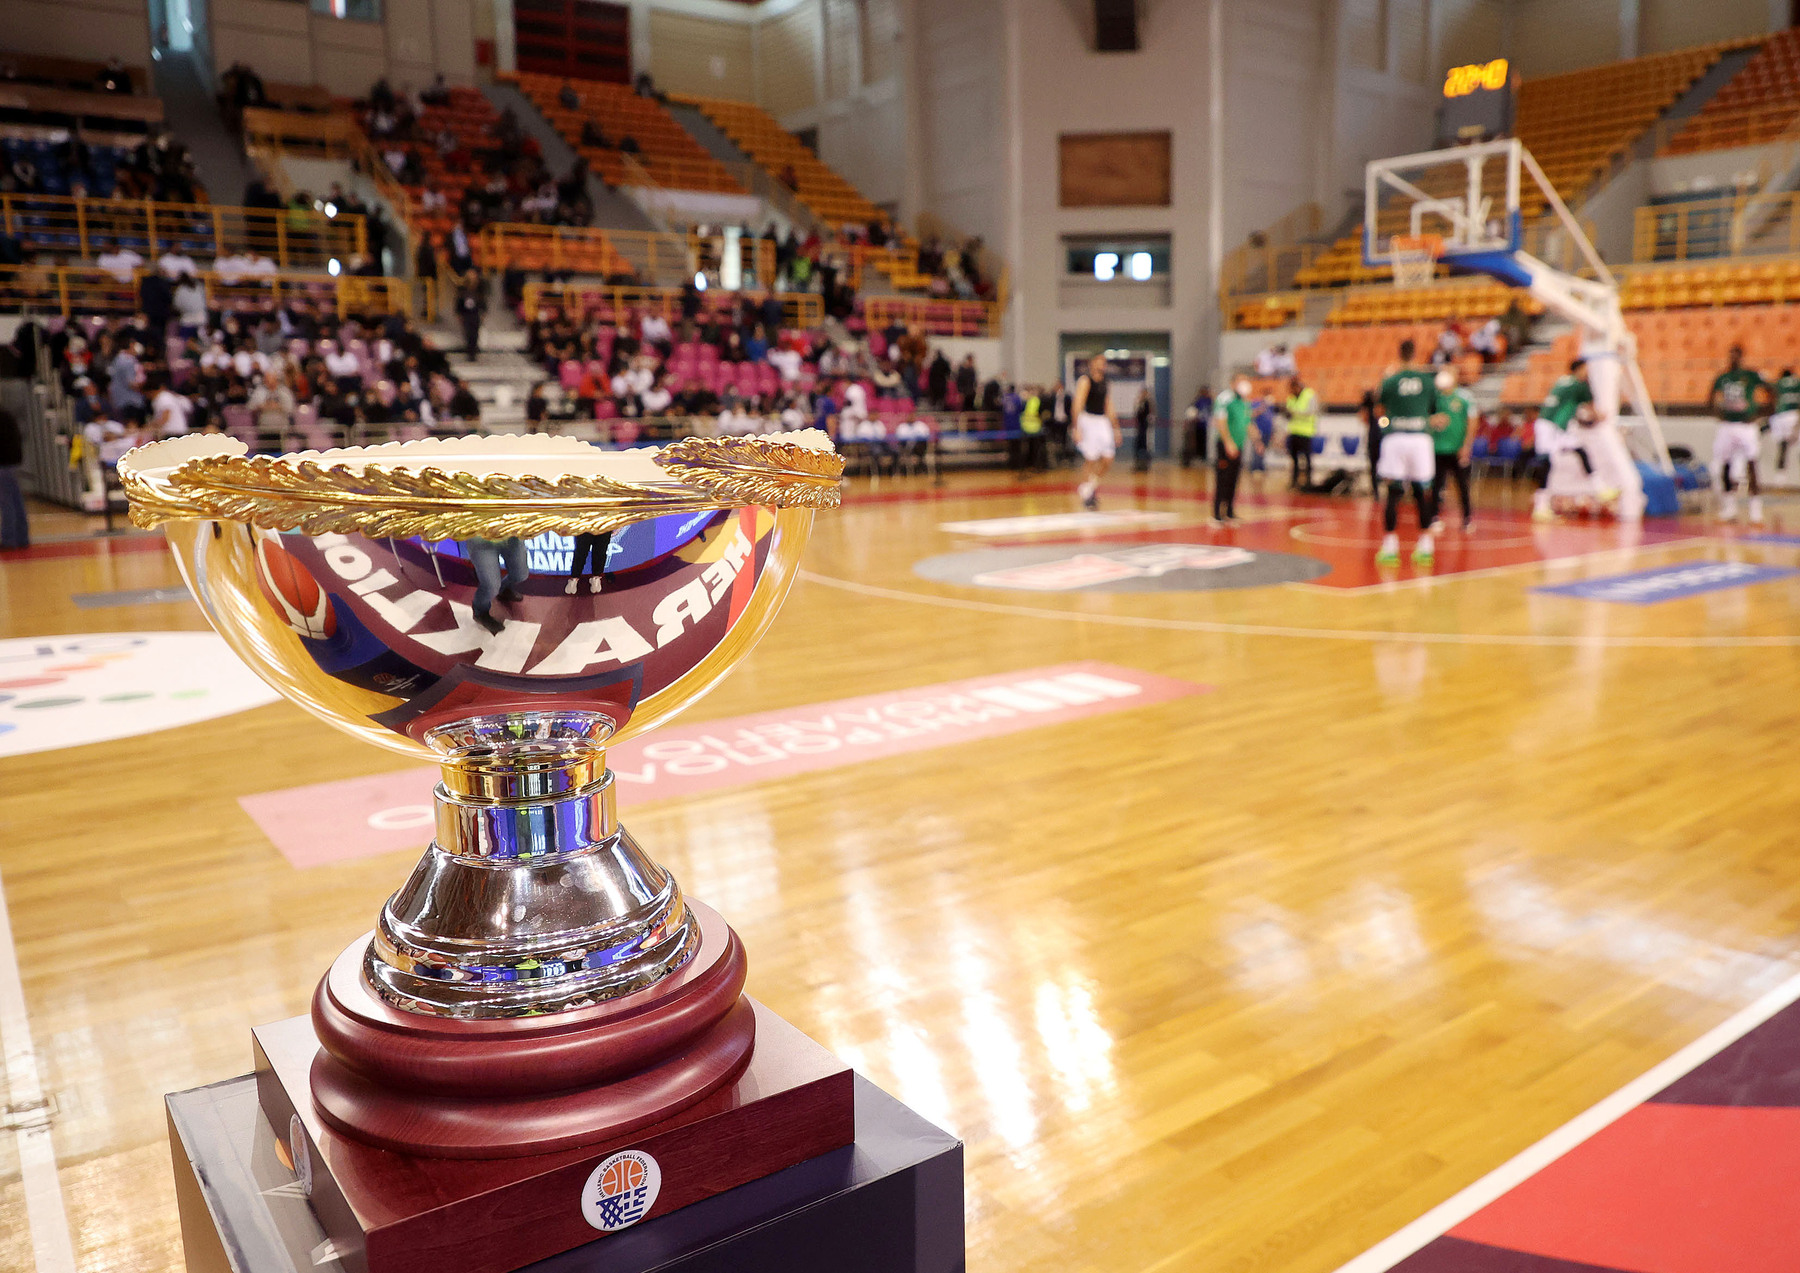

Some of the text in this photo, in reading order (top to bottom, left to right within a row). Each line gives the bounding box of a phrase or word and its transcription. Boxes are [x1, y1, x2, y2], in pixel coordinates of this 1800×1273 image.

[597, 1154, 648, 1199] HELLENIC BASKETBALL FEDERATION
